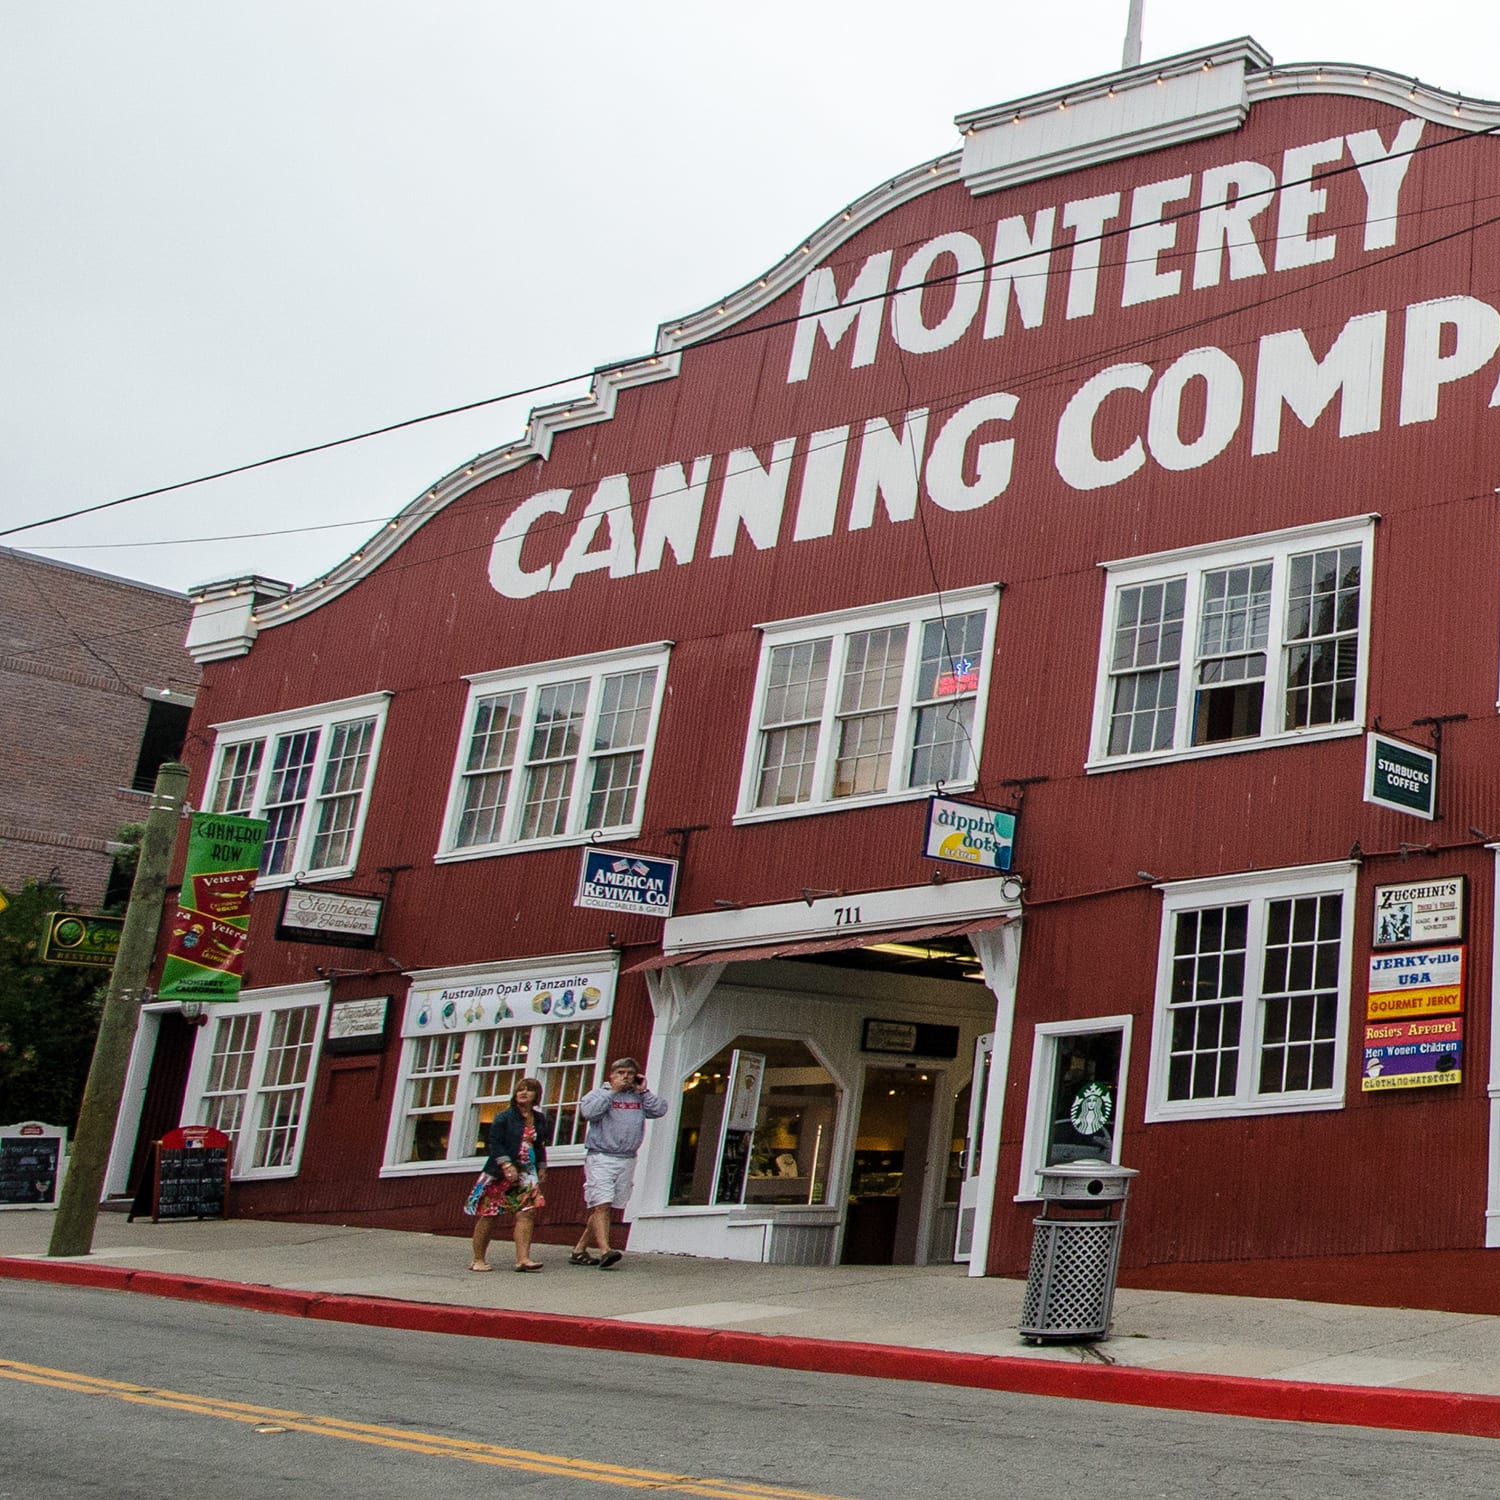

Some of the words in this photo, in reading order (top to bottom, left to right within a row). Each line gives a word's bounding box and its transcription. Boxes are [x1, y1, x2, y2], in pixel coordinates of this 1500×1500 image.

[787, 117, 1426, 384] MONTEREY
[488, 392, 1021, 599] CANNING
[1378, 758, 1430, 784] STARBUCKS
[1387, 773, 1420, 793] COFFEE
[197, 821, 262, 845] CANNERY
[962, 833, 1001, 853] dots
[211, 844, 243, 863] ROW
[593, 868, 664, 892] AMERICAN
[584, 882, 643, 903] REVIVAL
[1381, 884, 1457, 910] ZUCCHINI'S
[298, 894, 372, 917] Steinbeck
[317, 913, 368, 930] Jewelers
[834, 906, 862, 926] 711
[1372, 953, 1460, 970] JERKYville
[441, 986, 494, 1000] Australian
[496, 981, 523, 996] Opal
[524, 981, 533, 991] &
[535, 976, 589, 991] Tanzanite
[1398, 972, 1432, 985] USA
[1370, 998, 1423, 1013] GOURMET
[1426, 994, 1459, 1007] JERKY
[1366, 1026, 1402, 1040] Rosie's
[1407, 1021, 1457, 1036] Apparel
[1365, 1048, 1383, 1059] Men
[1387, 1045, 1417, 1056] Women
[1419, 1042, 1457, 1054] Children
